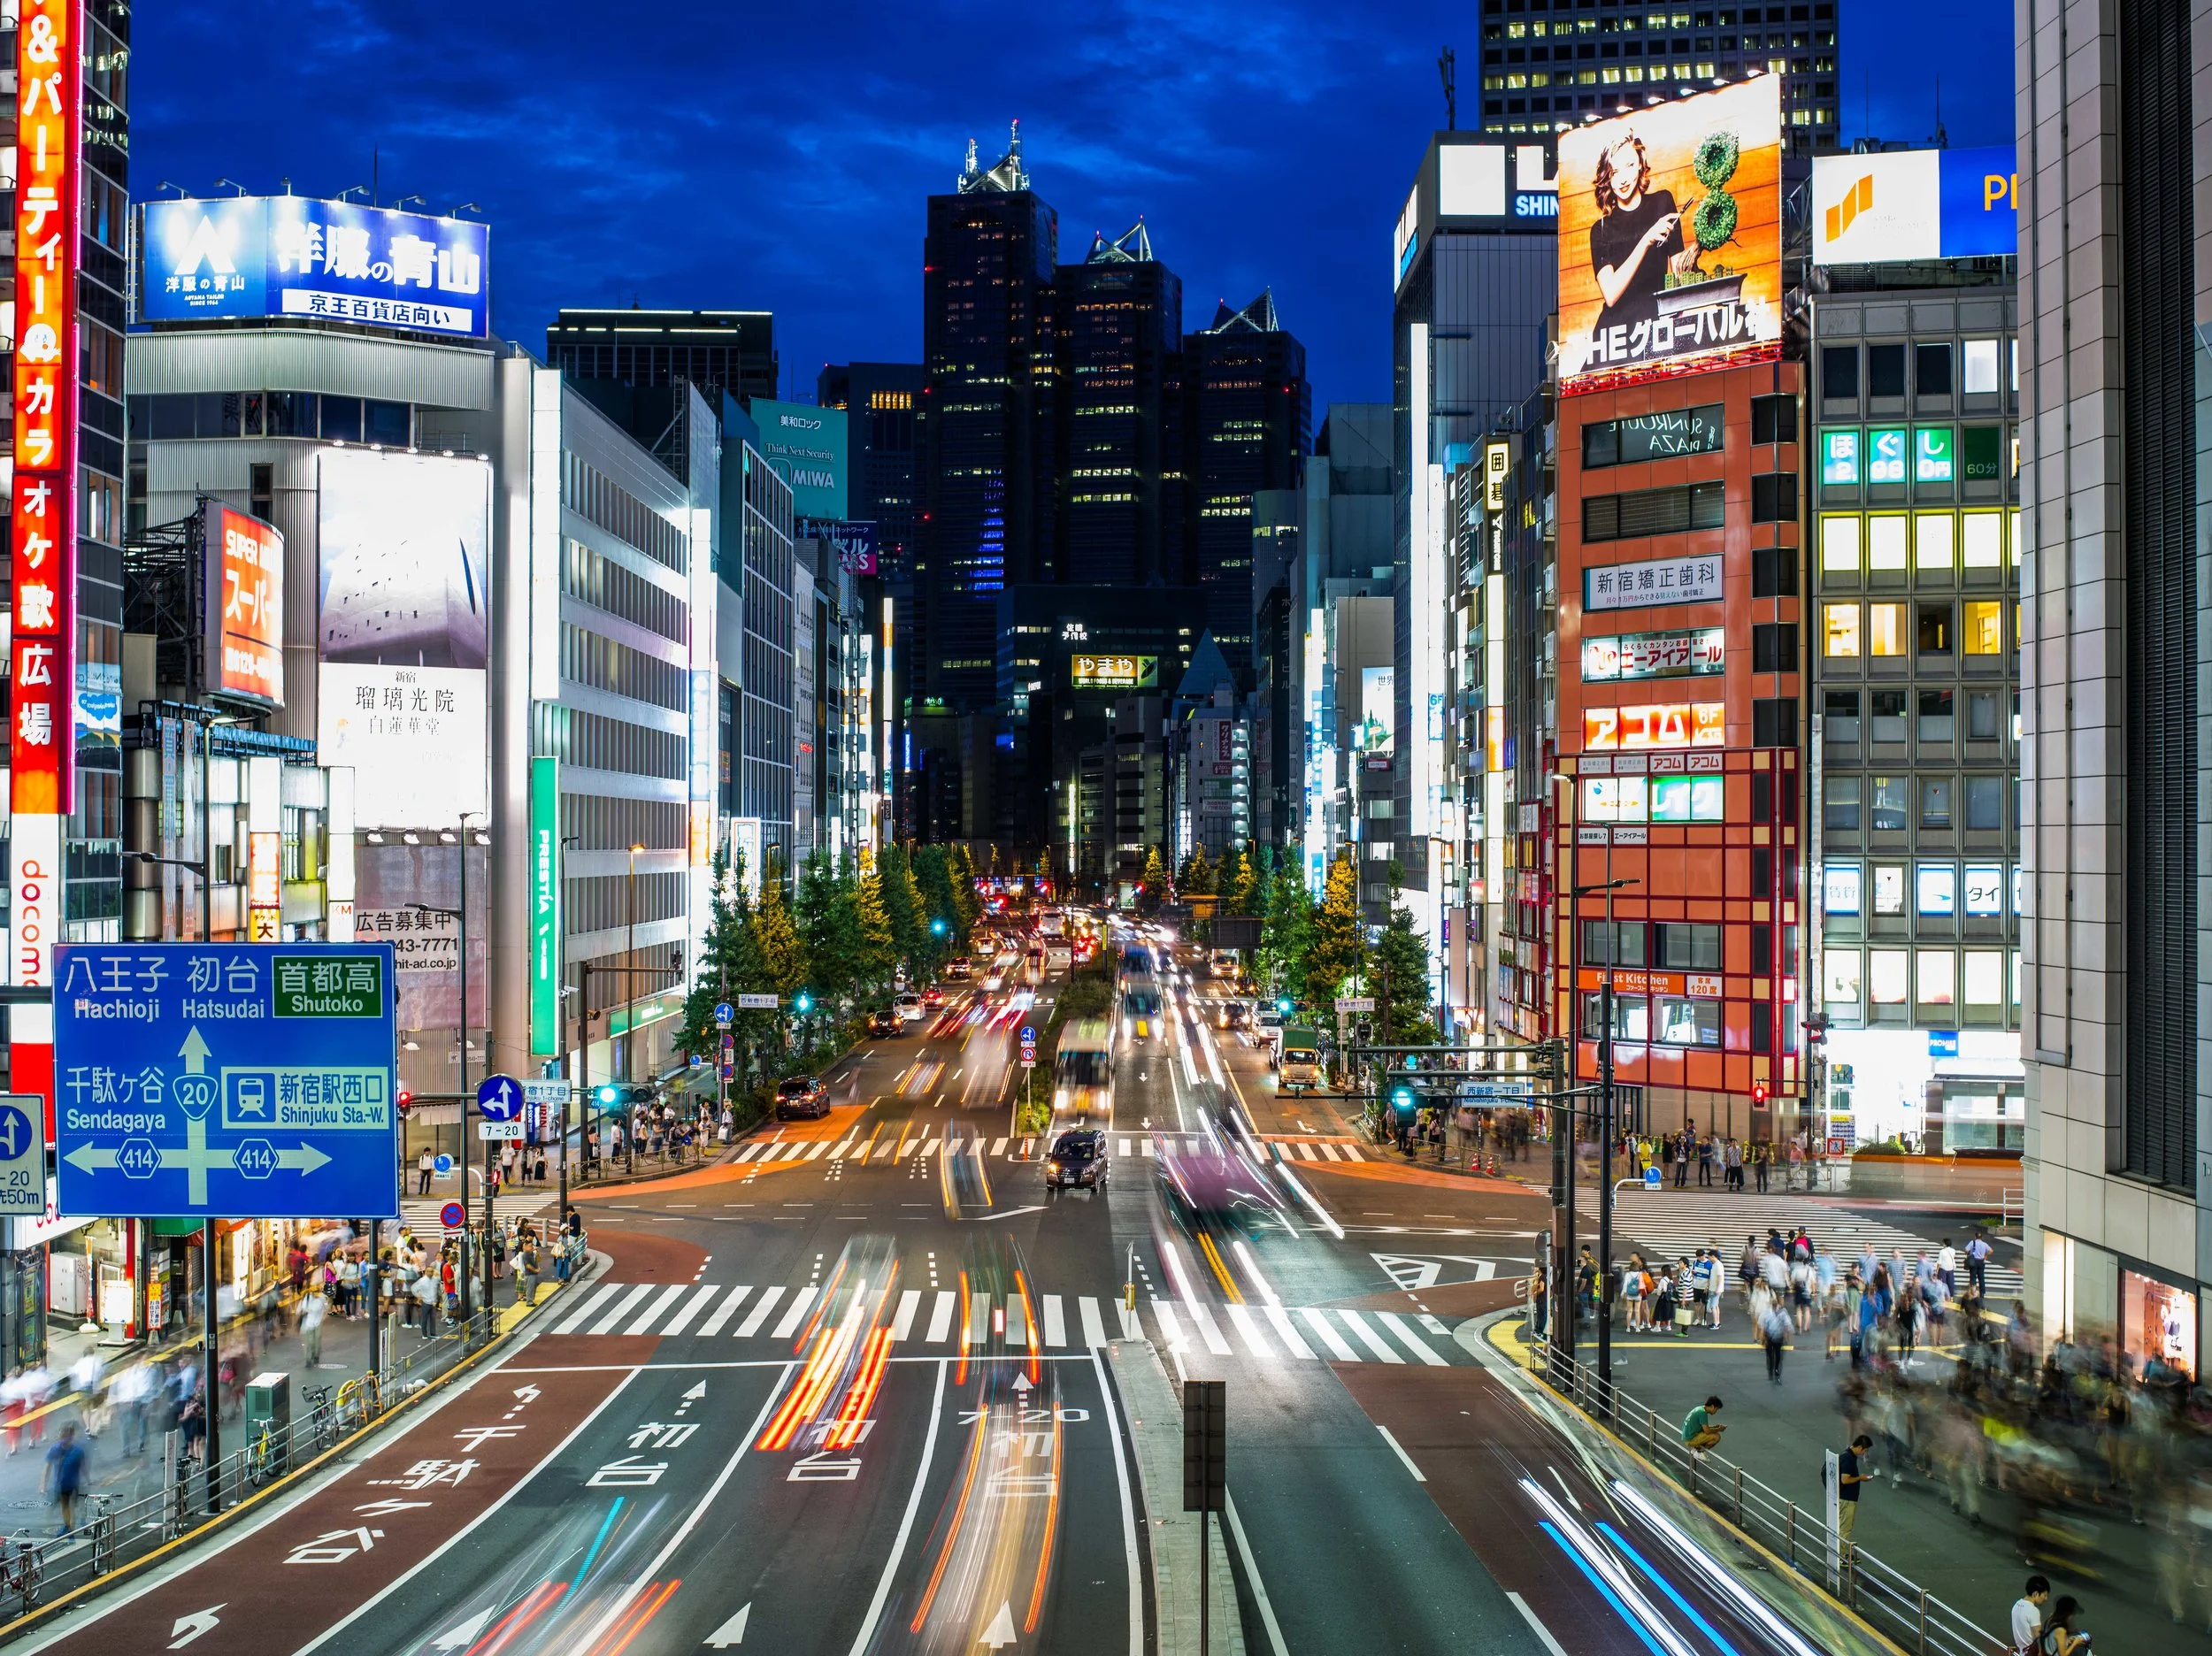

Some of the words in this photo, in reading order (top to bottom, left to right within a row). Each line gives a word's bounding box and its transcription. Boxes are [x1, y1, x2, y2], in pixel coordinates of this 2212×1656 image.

[274, 222, 480, 295] 洋服の青山
[165, 274, 245, 293] 洋服の青山
[309, 294, 450, 326] 京王百貨店向い
[780, 414, 821, 430] 美和ロック
[765, 442, 787, 454] Think
[788, 445, 805, 456] Next
[806, 448, 834, 462] Security
[1830, 432, 1945, 459] ほぐし
[793, 469, 835, 489] MIWA
[1967, 463, 1997, 475] 60分
[225, 528, 257, 567] SUPER
[19, 378, 55, 746] カラオケ歌広場
[1597, 562, 1716, 594] 新宿矯正歯科
[1624, 638, 1710, 651] らくらくカンタンお部屋さ
[1078, 657, 1133, 677] やまや
[1620, 645, 1723, 669] エーアイアール
[396, 671, 417, 684] 新宿
[356, 686, 454, 713] 瑠璃光院
[1586, 706, 1686, 744] アコム
[1698, 709, 1719, 724] 6F
[1654, 757, 1682, 770] アコム
[1691, 756, 1719, 768] アコム
[356, 911, 451, 932] 広告募集中
[388, 938, 457, 953] 43-7771
[395, 957, 457, 970] hit-ad.co.jp
[65, 956, 169, 993] 八王子
[187, 955, 259, 993] 初台
[279, 962, 376, 993] 首都高
[1596, 972, 1623, 984] Fist
[1626, 973, 1669, 985] Kitchen
[1690, 985, 1717, 995] 120席
[74, 999, 160, 1023] Hachioji
[182, 999, 265, 1019] Hatsudai
[291, 994, 364, 1013] Shutoko
[182, 1083, 210, 1105] 20
[280, 1073, 384, 1104] 新宿駅西口
[1467, 1086, 1520, 1095] 西新宿一丁目
[66, 1108, 165, 1133] Sendagaya
[280, 1106, 339, 1126] Shinjuku
[342, 1106, 384, 1123] Sta.-W.
[486, 1126, 518, 1137] 7-20
[124, 1150, 154, 1169] 414
[241, 1150, 271, 1169] 414
[0, 1170, 30, 1186] -20
[957, 1408, 1090, 1425] 7-20
[585, 1421, 700, 1487] 初台
